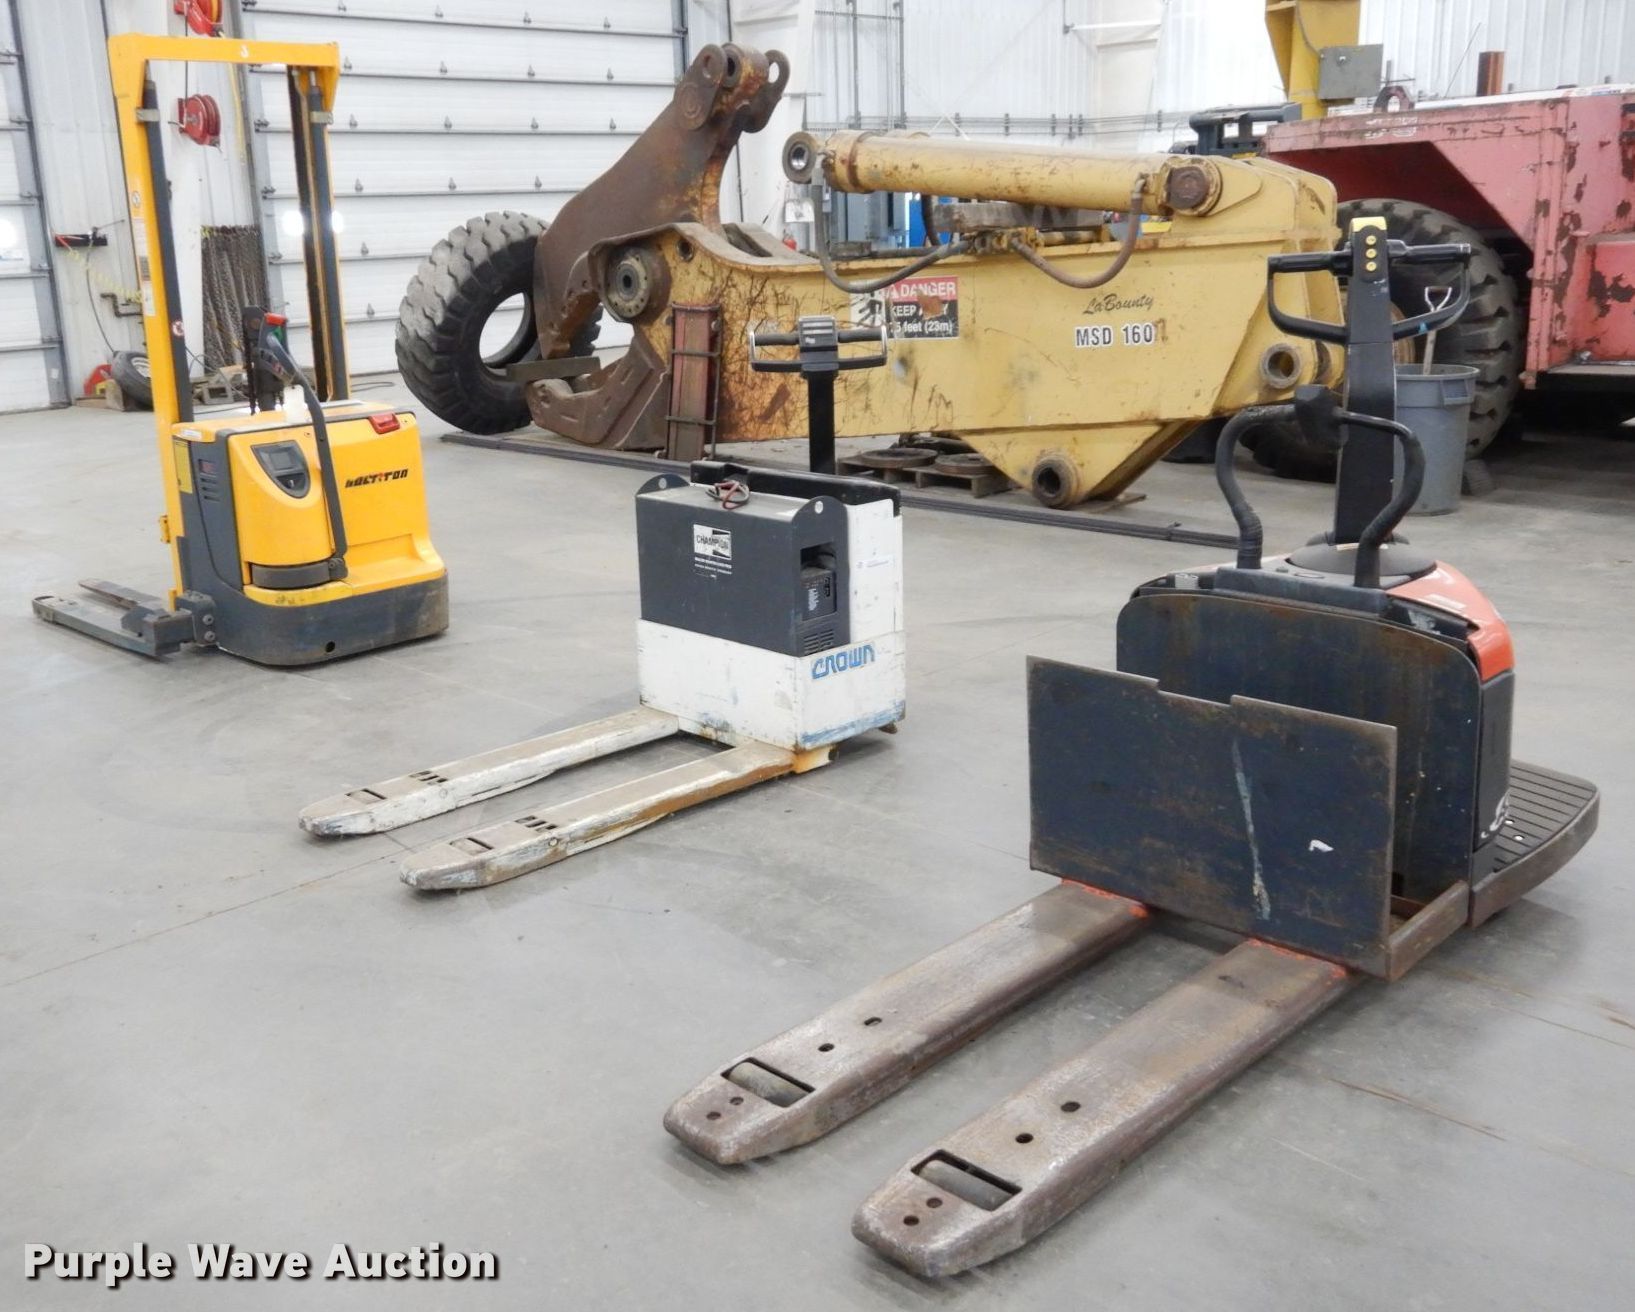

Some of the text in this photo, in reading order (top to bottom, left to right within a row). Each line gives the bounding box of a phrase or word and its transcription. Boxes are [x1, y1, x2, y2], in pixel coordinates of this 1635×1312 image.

[900, 282, 956, 298] DANGER
[1083, 293, 1153, 315] LaBounty
[904, 320, 922, 333] feet
[1076, 324, 1153, 346] MSD 160
[812, 644, 875, 679] CROWN
